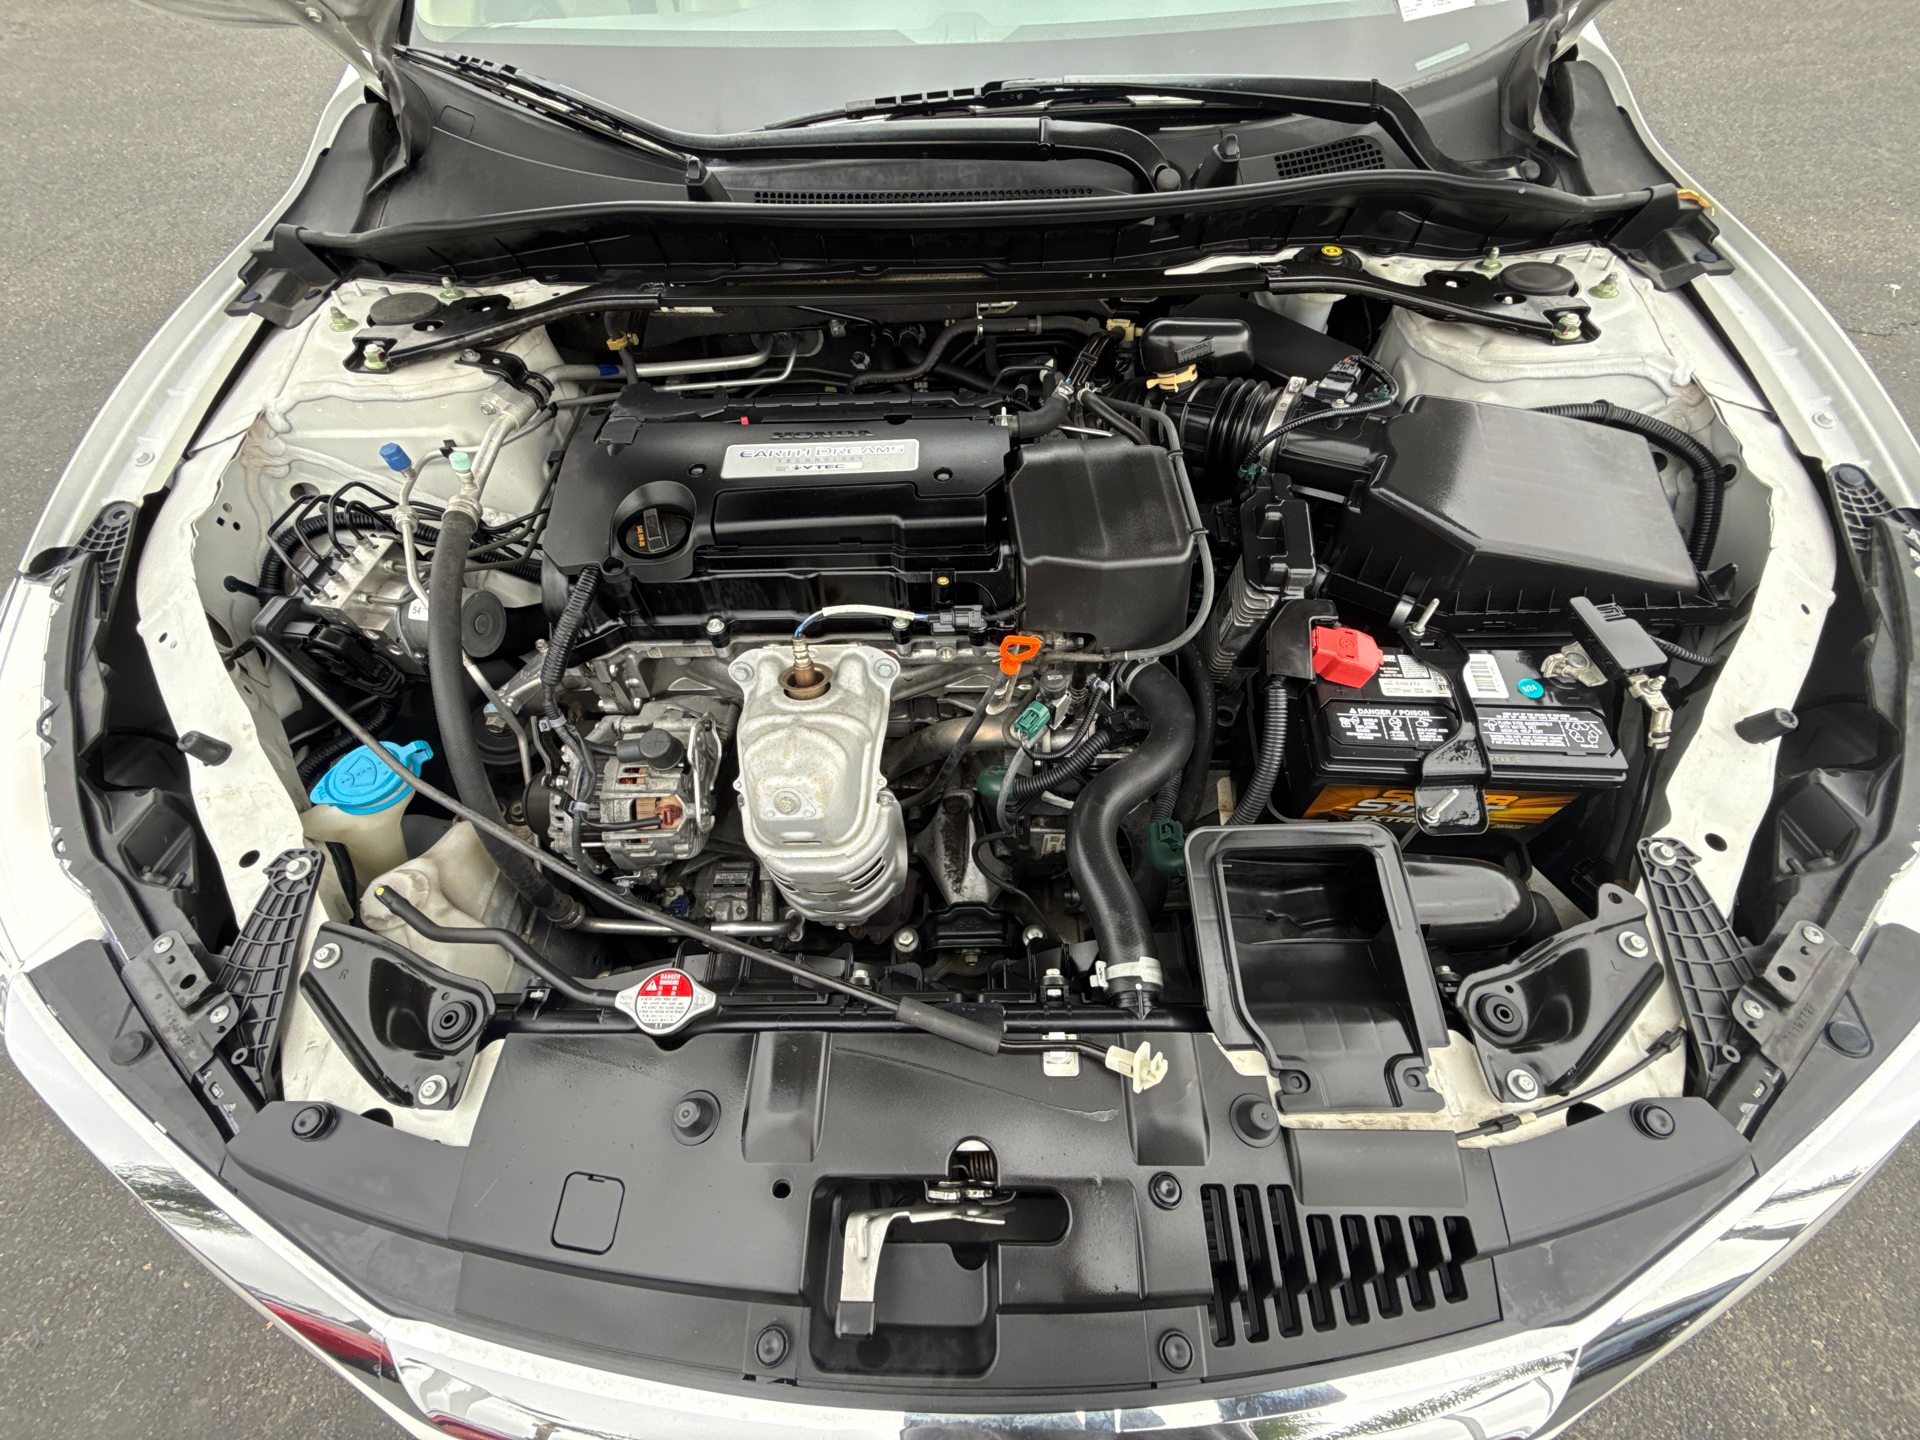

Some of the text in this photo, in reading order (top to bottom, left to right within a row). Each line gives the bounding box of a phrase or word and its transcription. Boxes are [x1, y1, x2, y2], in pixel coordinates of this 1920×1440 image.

[770, 430, 875, 441] HONDA
[739, 445, 905, 458] EARTH DREAMS
[777, 455, 864, 464] TECHNOLOGY
[412, 605, 422, 615] 54
[1521, 684, 1538, 693] 9/24
[1357, 708, 1392, 716] DANGER
[1399, 709, 1431, 717] POISON
[317, 785, 327, 801] PULL
[338, 968, 349, 980] R
